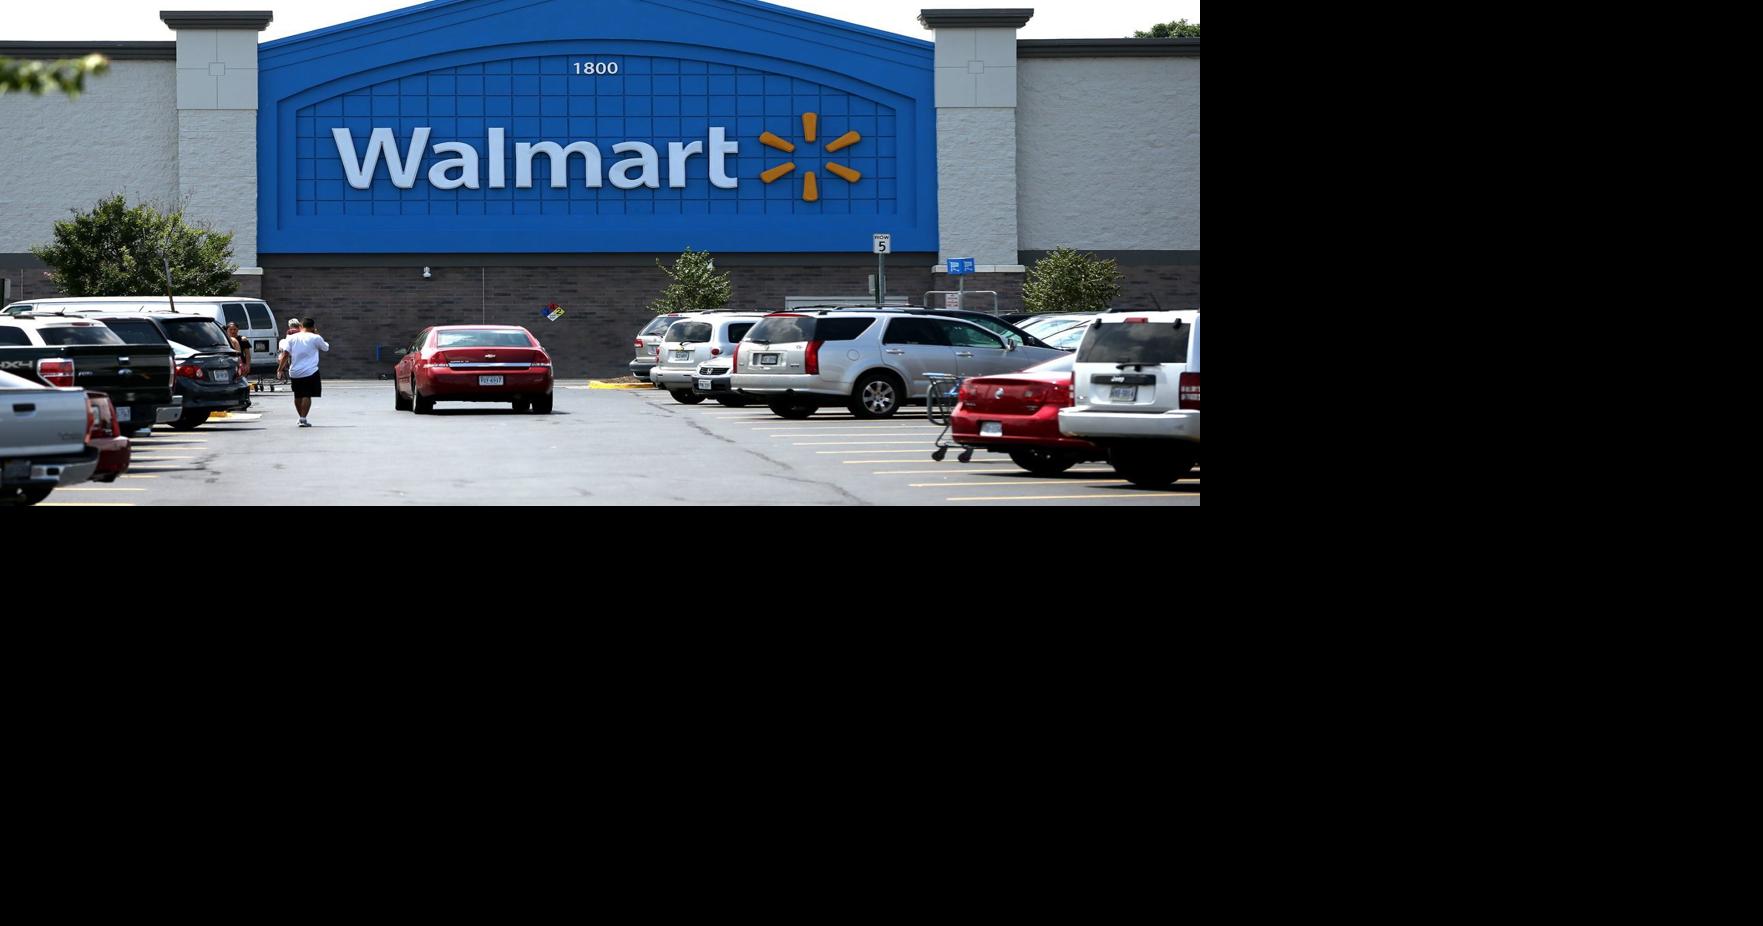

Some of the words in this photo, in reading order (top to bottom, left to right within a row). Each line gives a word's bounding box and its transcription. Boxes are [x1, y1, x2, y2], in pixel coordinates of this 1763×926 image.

[573, 62, 618, 75] 1800
[331, 126, 738, 189] Walmart
[878, 241, 886, 252] 5
